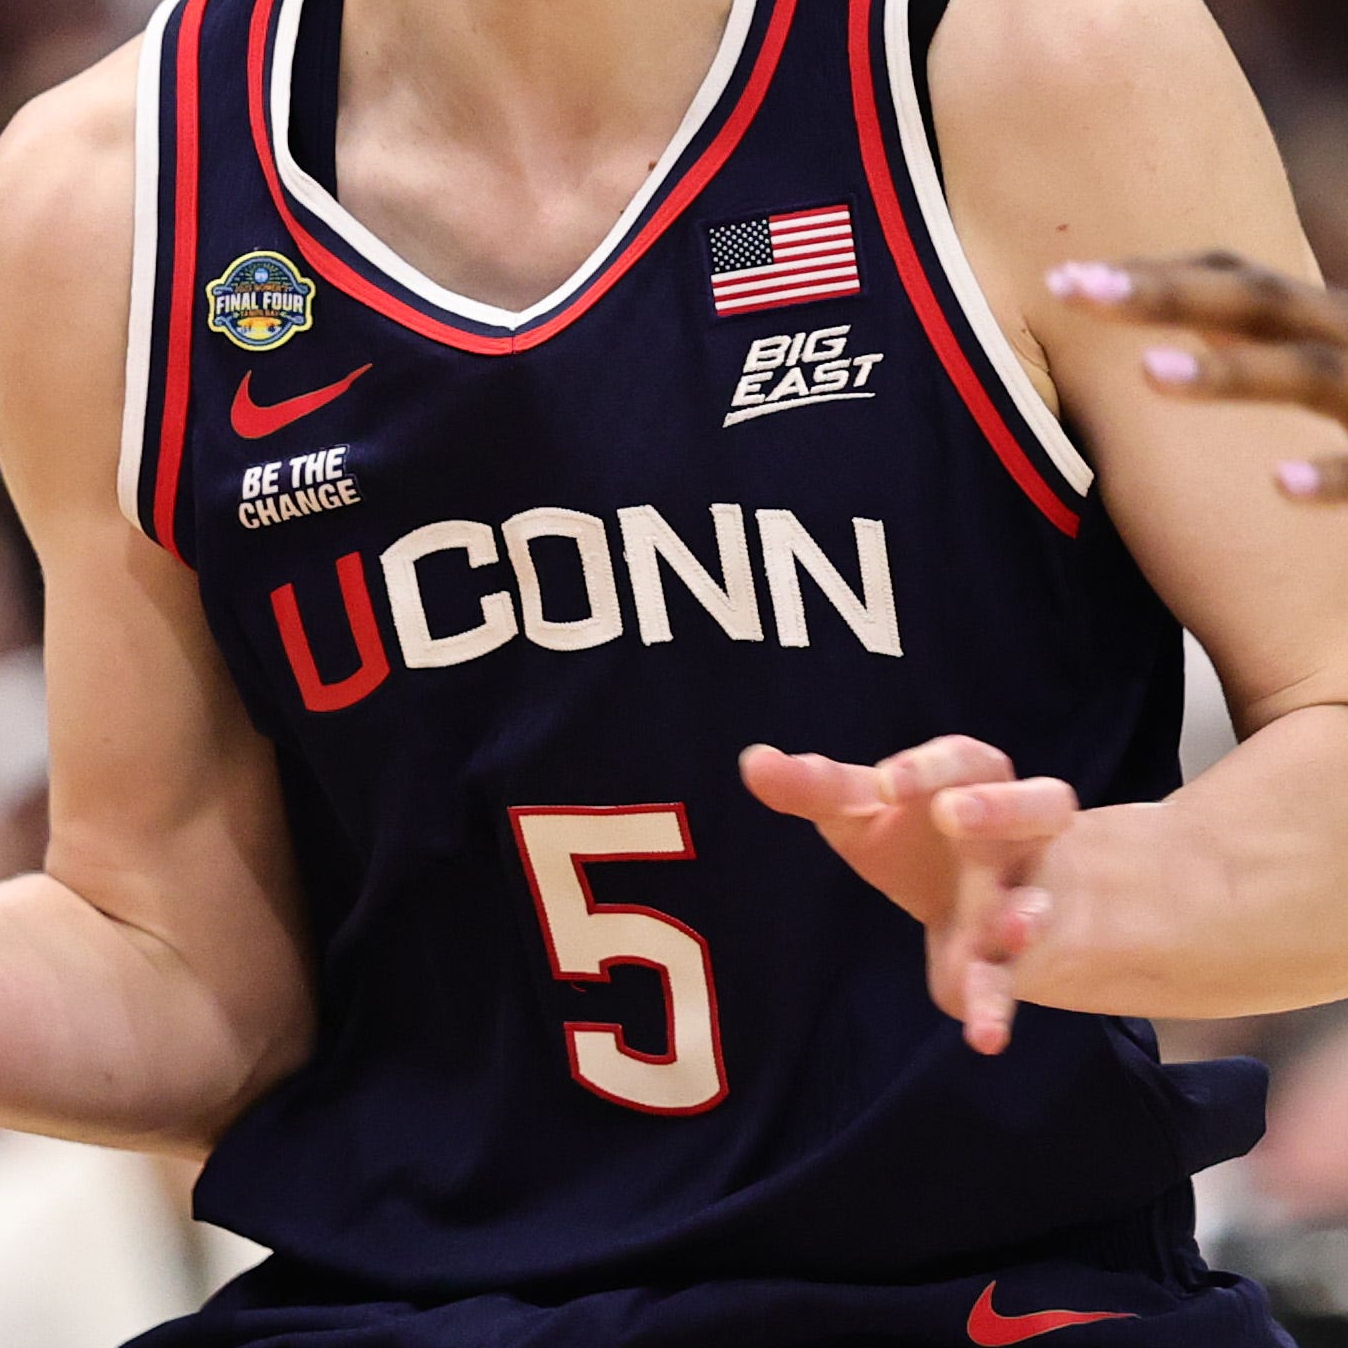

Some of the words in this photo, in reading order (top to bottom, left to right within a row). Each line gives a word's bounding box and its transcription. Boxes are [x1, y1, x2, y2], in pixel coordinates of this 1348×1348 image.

[216, 292, 259, 314] FINAL
[262, 292, 304, 313] FOUR
[743, 324, 851, 373] BIG
[731, 353, 884, 407] EAST
[242, 461, 282, 500] BE
[289, 446, 347, 489] THE
[238, 478, 361, 529] CHANGE
[271, 503, 904, 713] UCONN
[508, 801, 729, 1117] 5
